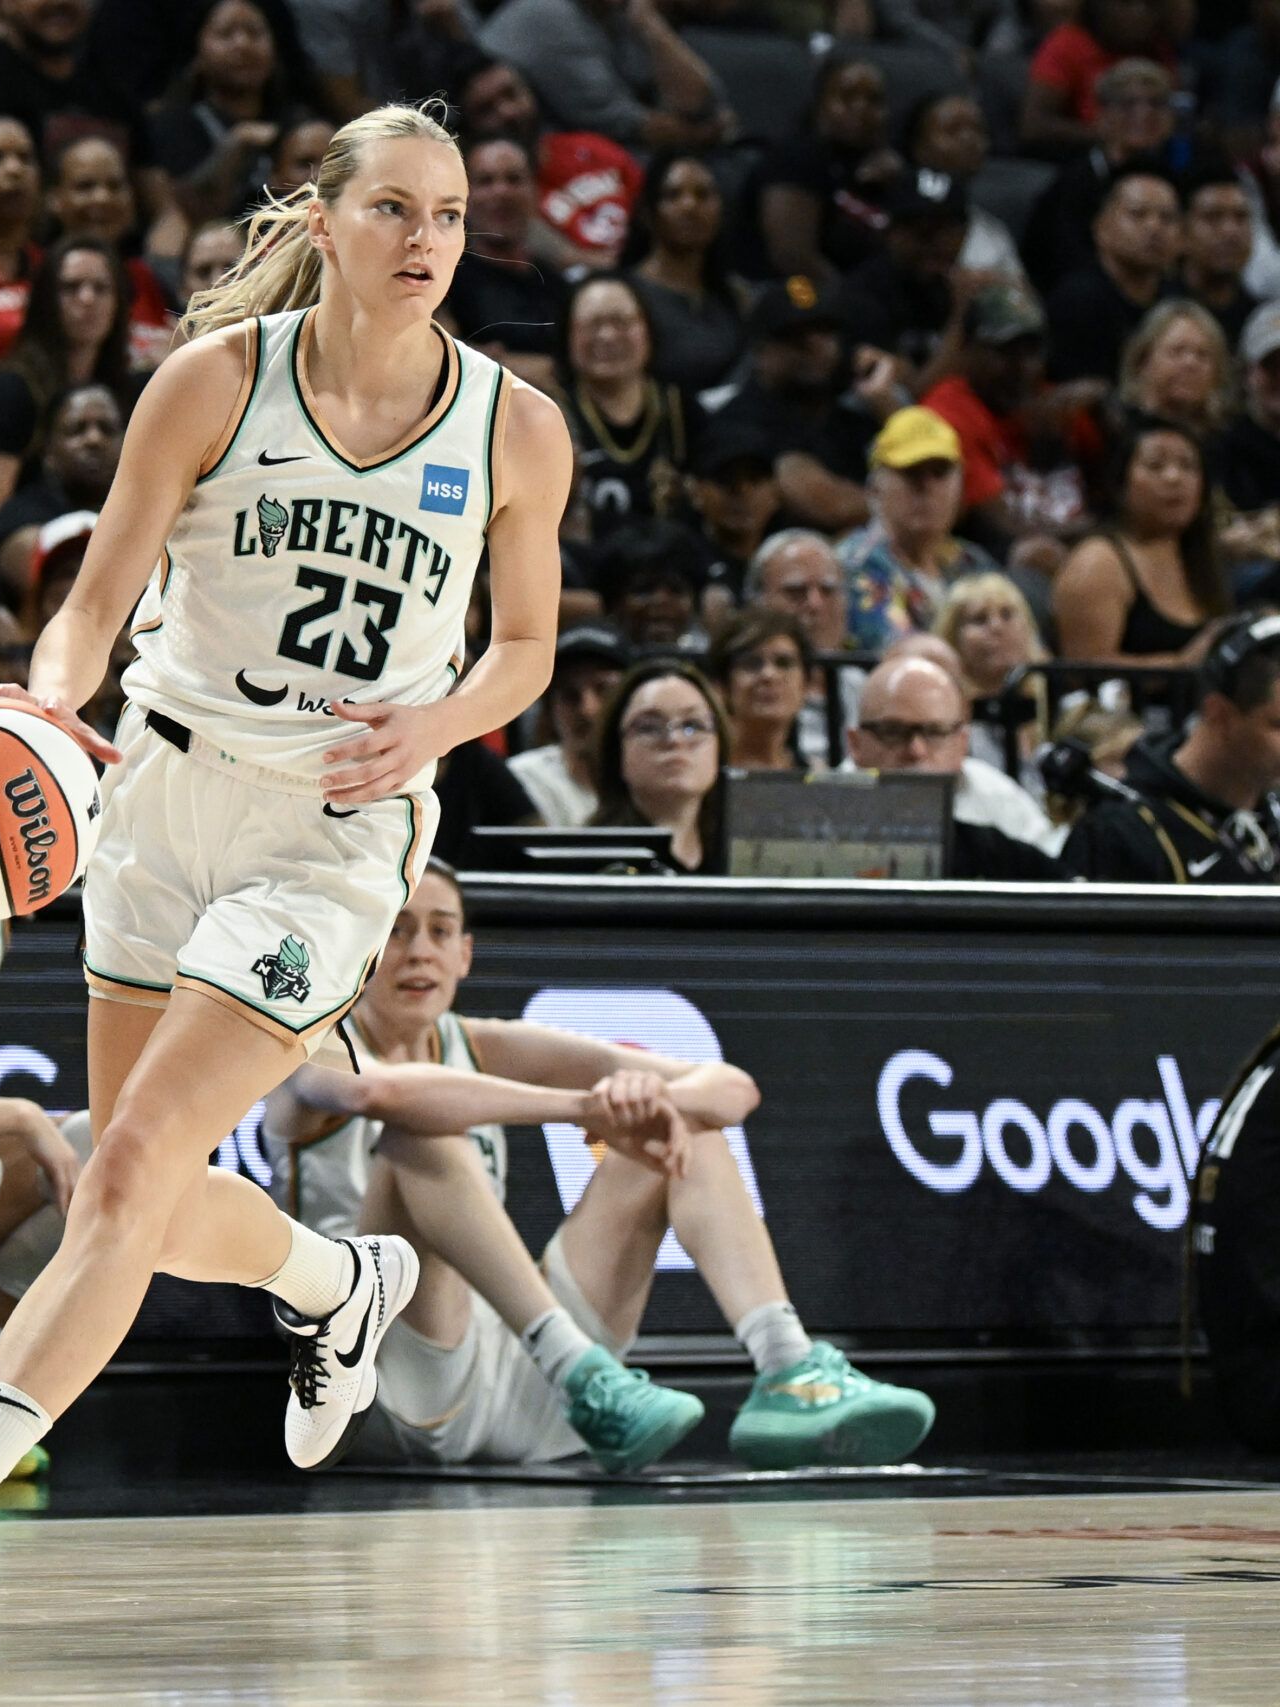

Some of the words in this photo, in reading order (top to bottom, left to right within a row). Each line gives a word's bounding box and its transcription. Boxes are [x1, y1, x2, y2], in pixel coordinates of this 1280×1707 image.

[426, 480, 464, 500] HSS
[276, 566, 403, 682] 23
[4, 766, 57, 904] Wilson
